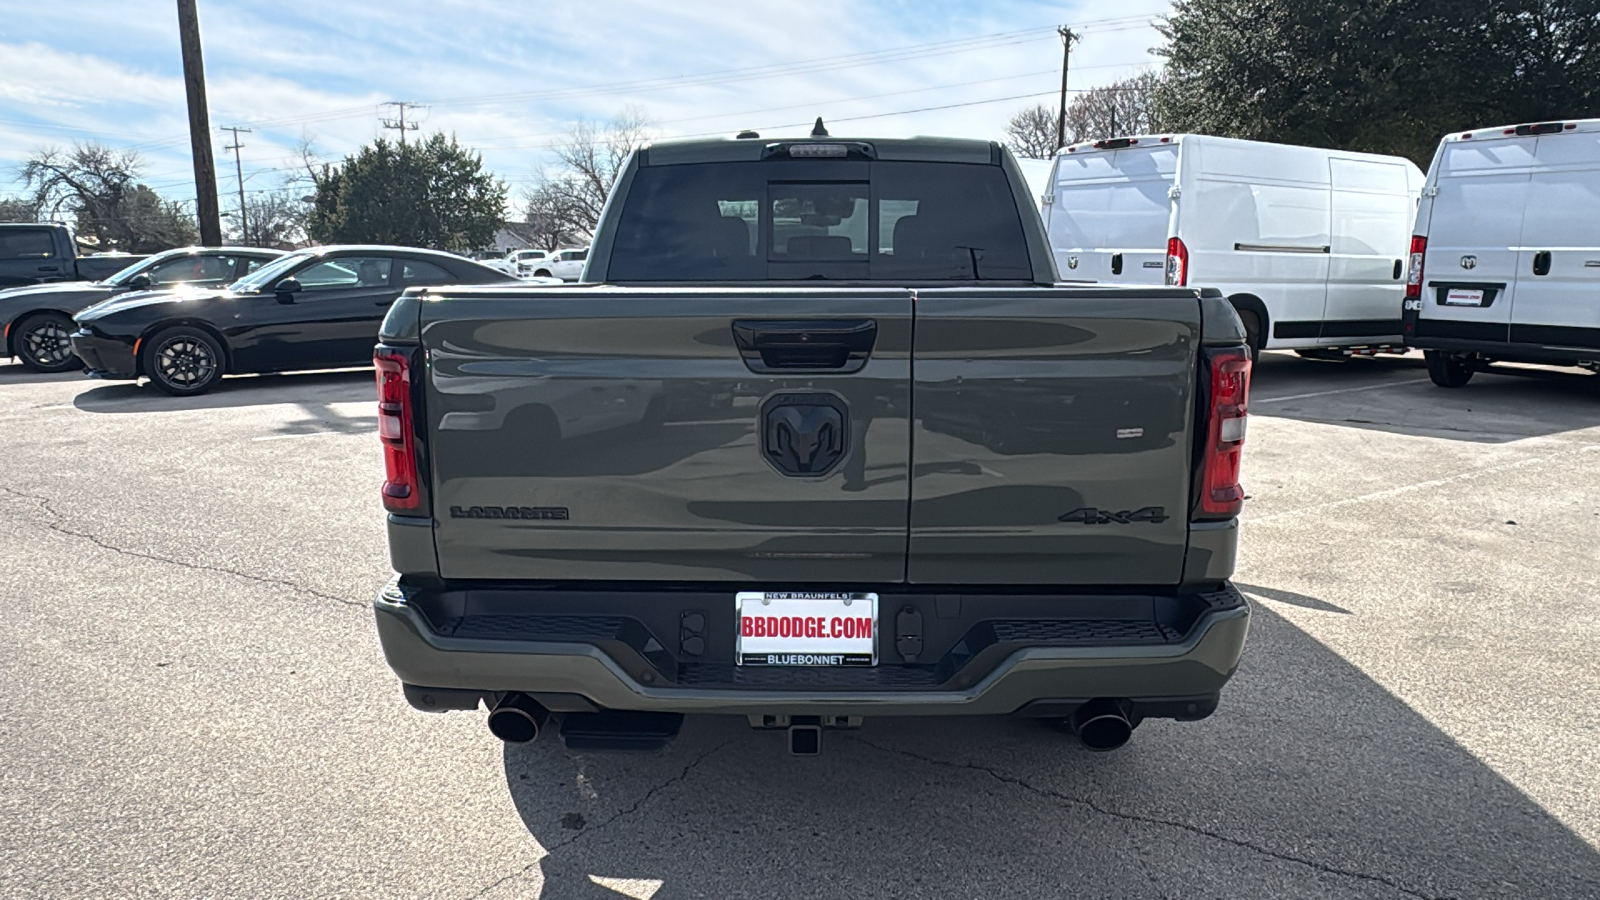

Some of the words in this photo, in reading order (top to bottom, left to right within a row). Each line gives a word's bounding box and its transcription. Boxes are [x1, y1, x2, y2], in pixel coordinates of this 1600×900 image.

[449, 506, 569, 520] LARAMIE
[741, 616, 872, 638] BBDODGE.COM
[767, 655, 844, 665] BLUEBONNET
